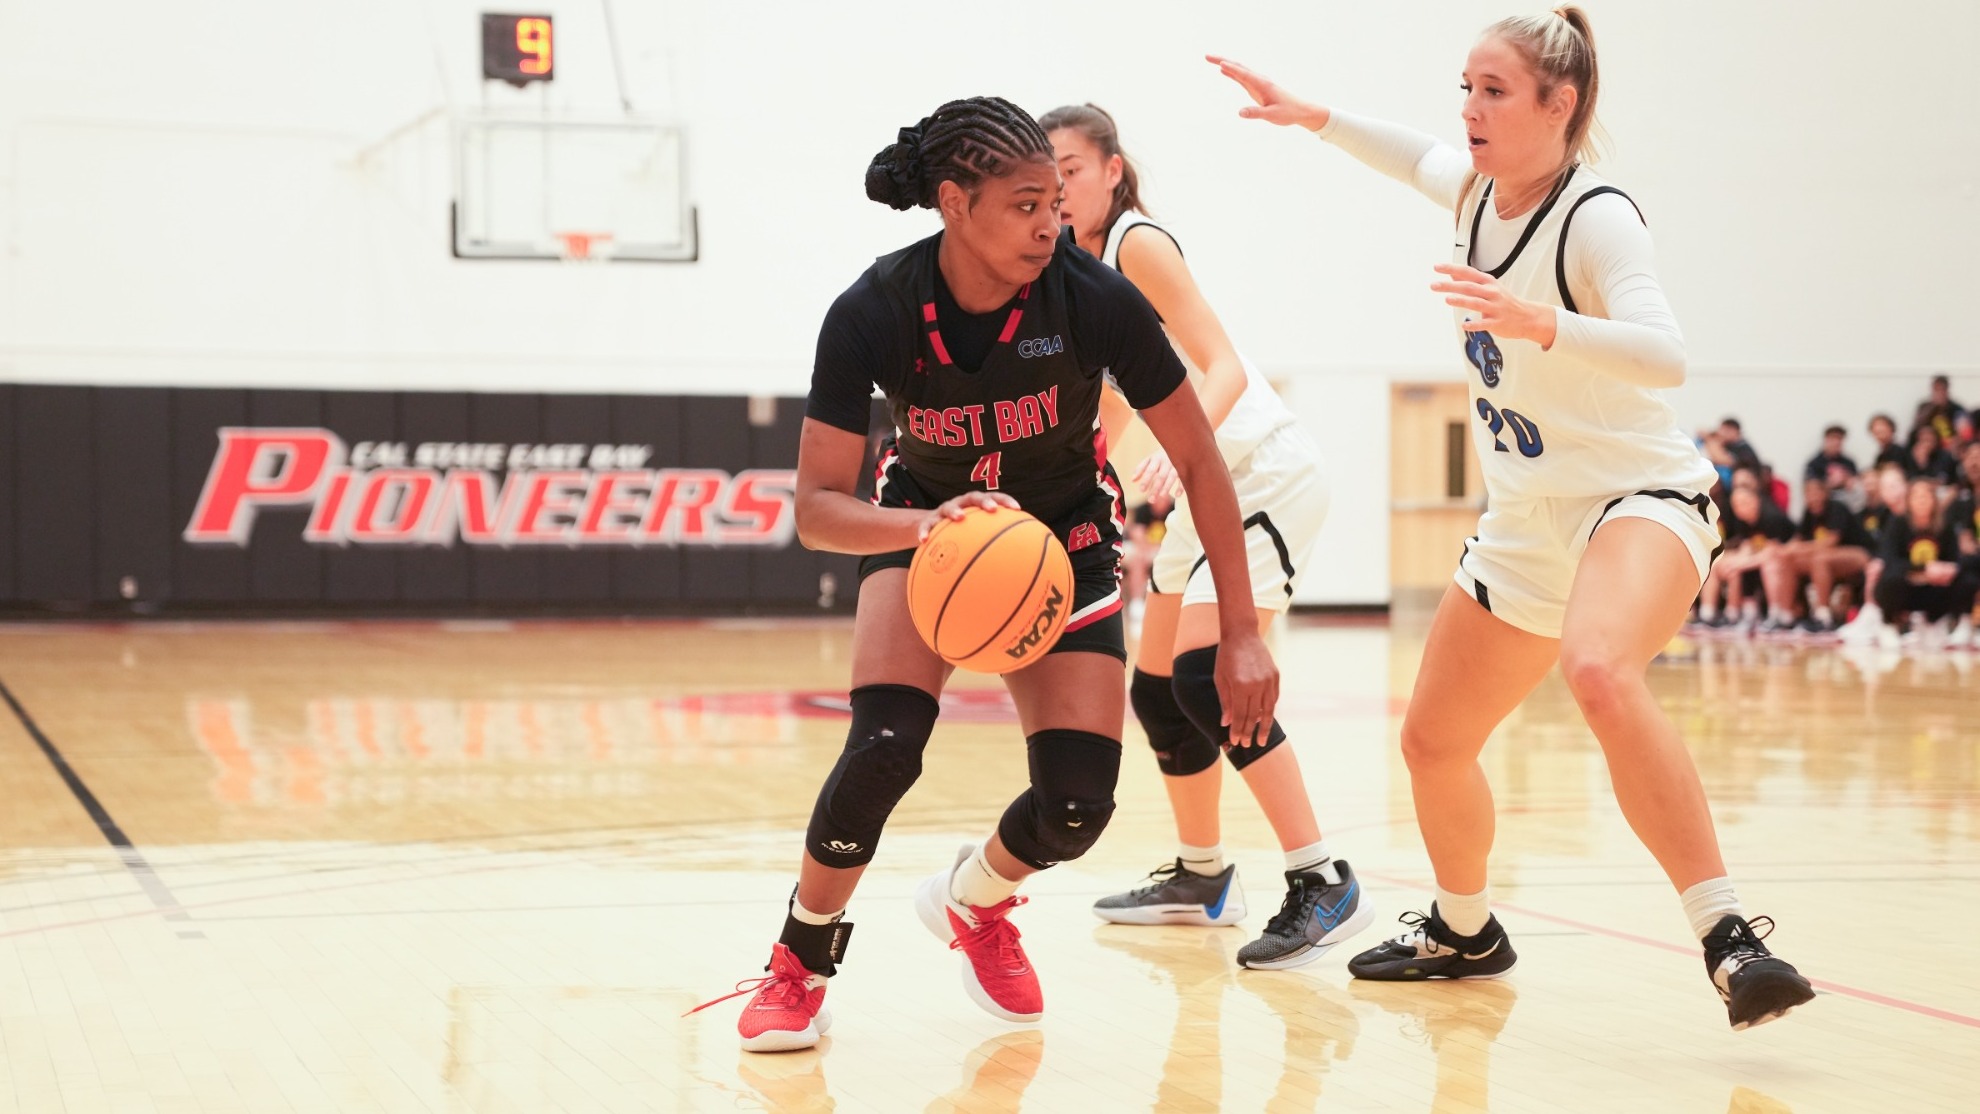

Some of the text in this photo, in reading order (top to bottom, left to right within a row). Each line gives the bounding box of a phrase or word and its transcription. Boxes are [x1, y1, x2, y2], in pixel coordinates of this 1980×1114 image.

[516, 18, 551, 74] 9
[1018, 335, 1064, 358] CCAA
[908, 385, 1059, 446] EAST BAY
[1476, 397, 1543, 458] 20
[351, 441, 652, 470] CAL STATE EAST BAY
[970, 452, 1002, 490] 4
[183, 427, 797, 548] PIONEERS
[1005, 584, 1064, 659] NCAA
